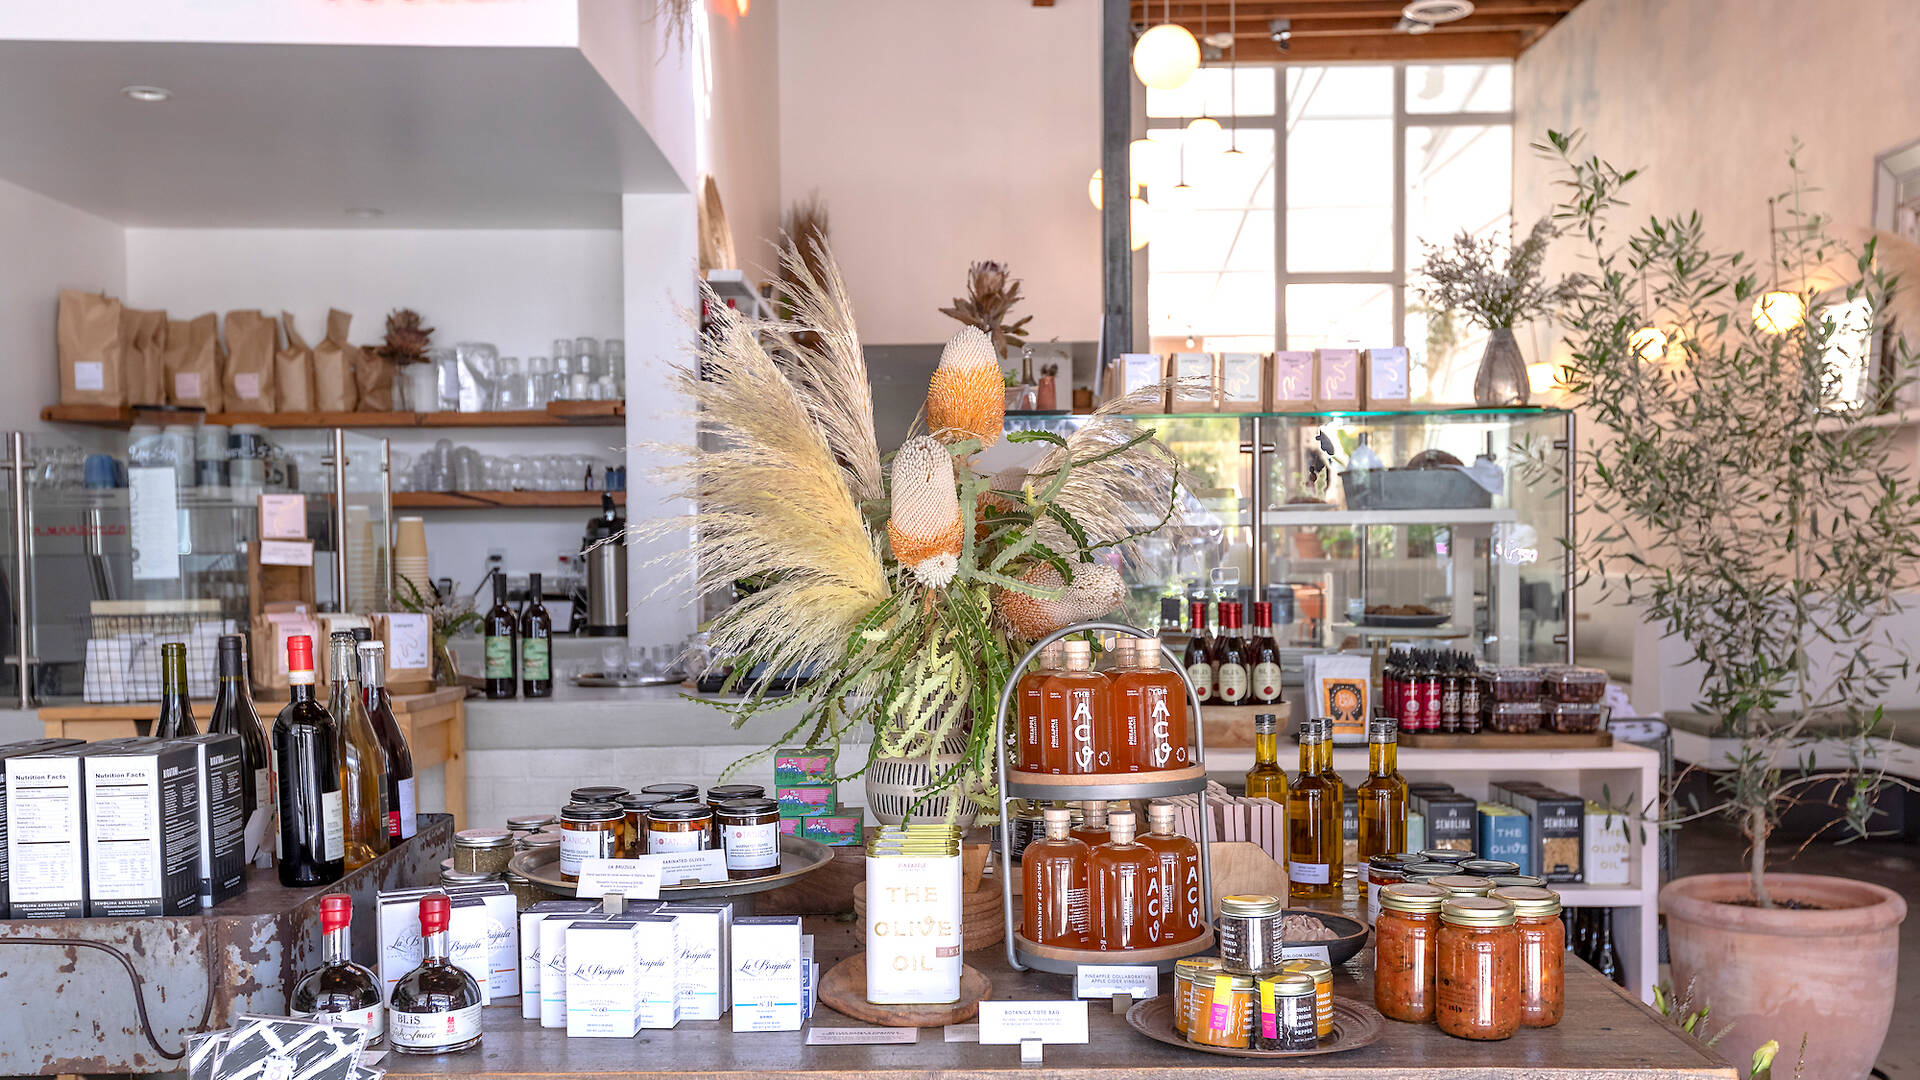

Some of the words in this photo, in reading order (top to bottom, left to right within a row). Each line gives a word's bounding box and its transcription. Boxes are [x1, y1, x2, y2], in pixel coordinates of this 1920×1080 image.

[1435, 819, 1471, 829] SEMOLINA
[1543, 817, 1579, 829] SEMOLINA
[1496, 828, 1522, 838] THE
[1490, 843, 1528, 854] OLIVE
[1186, 855, 1197, 863] THE
[1600, 861, 1619, 870] OIL
[885, 886, 938, 902] THE
[1037, 892, 1042, 900] OF
[874, 916, 952, 937] OLIVE
[892, 955, 933, 971] OIL
[330, 1014, 342, 1024] iS
[397, 1013, 421, 1025] BLiS
[1294, 1028, 1313, 1036] PEPPER
